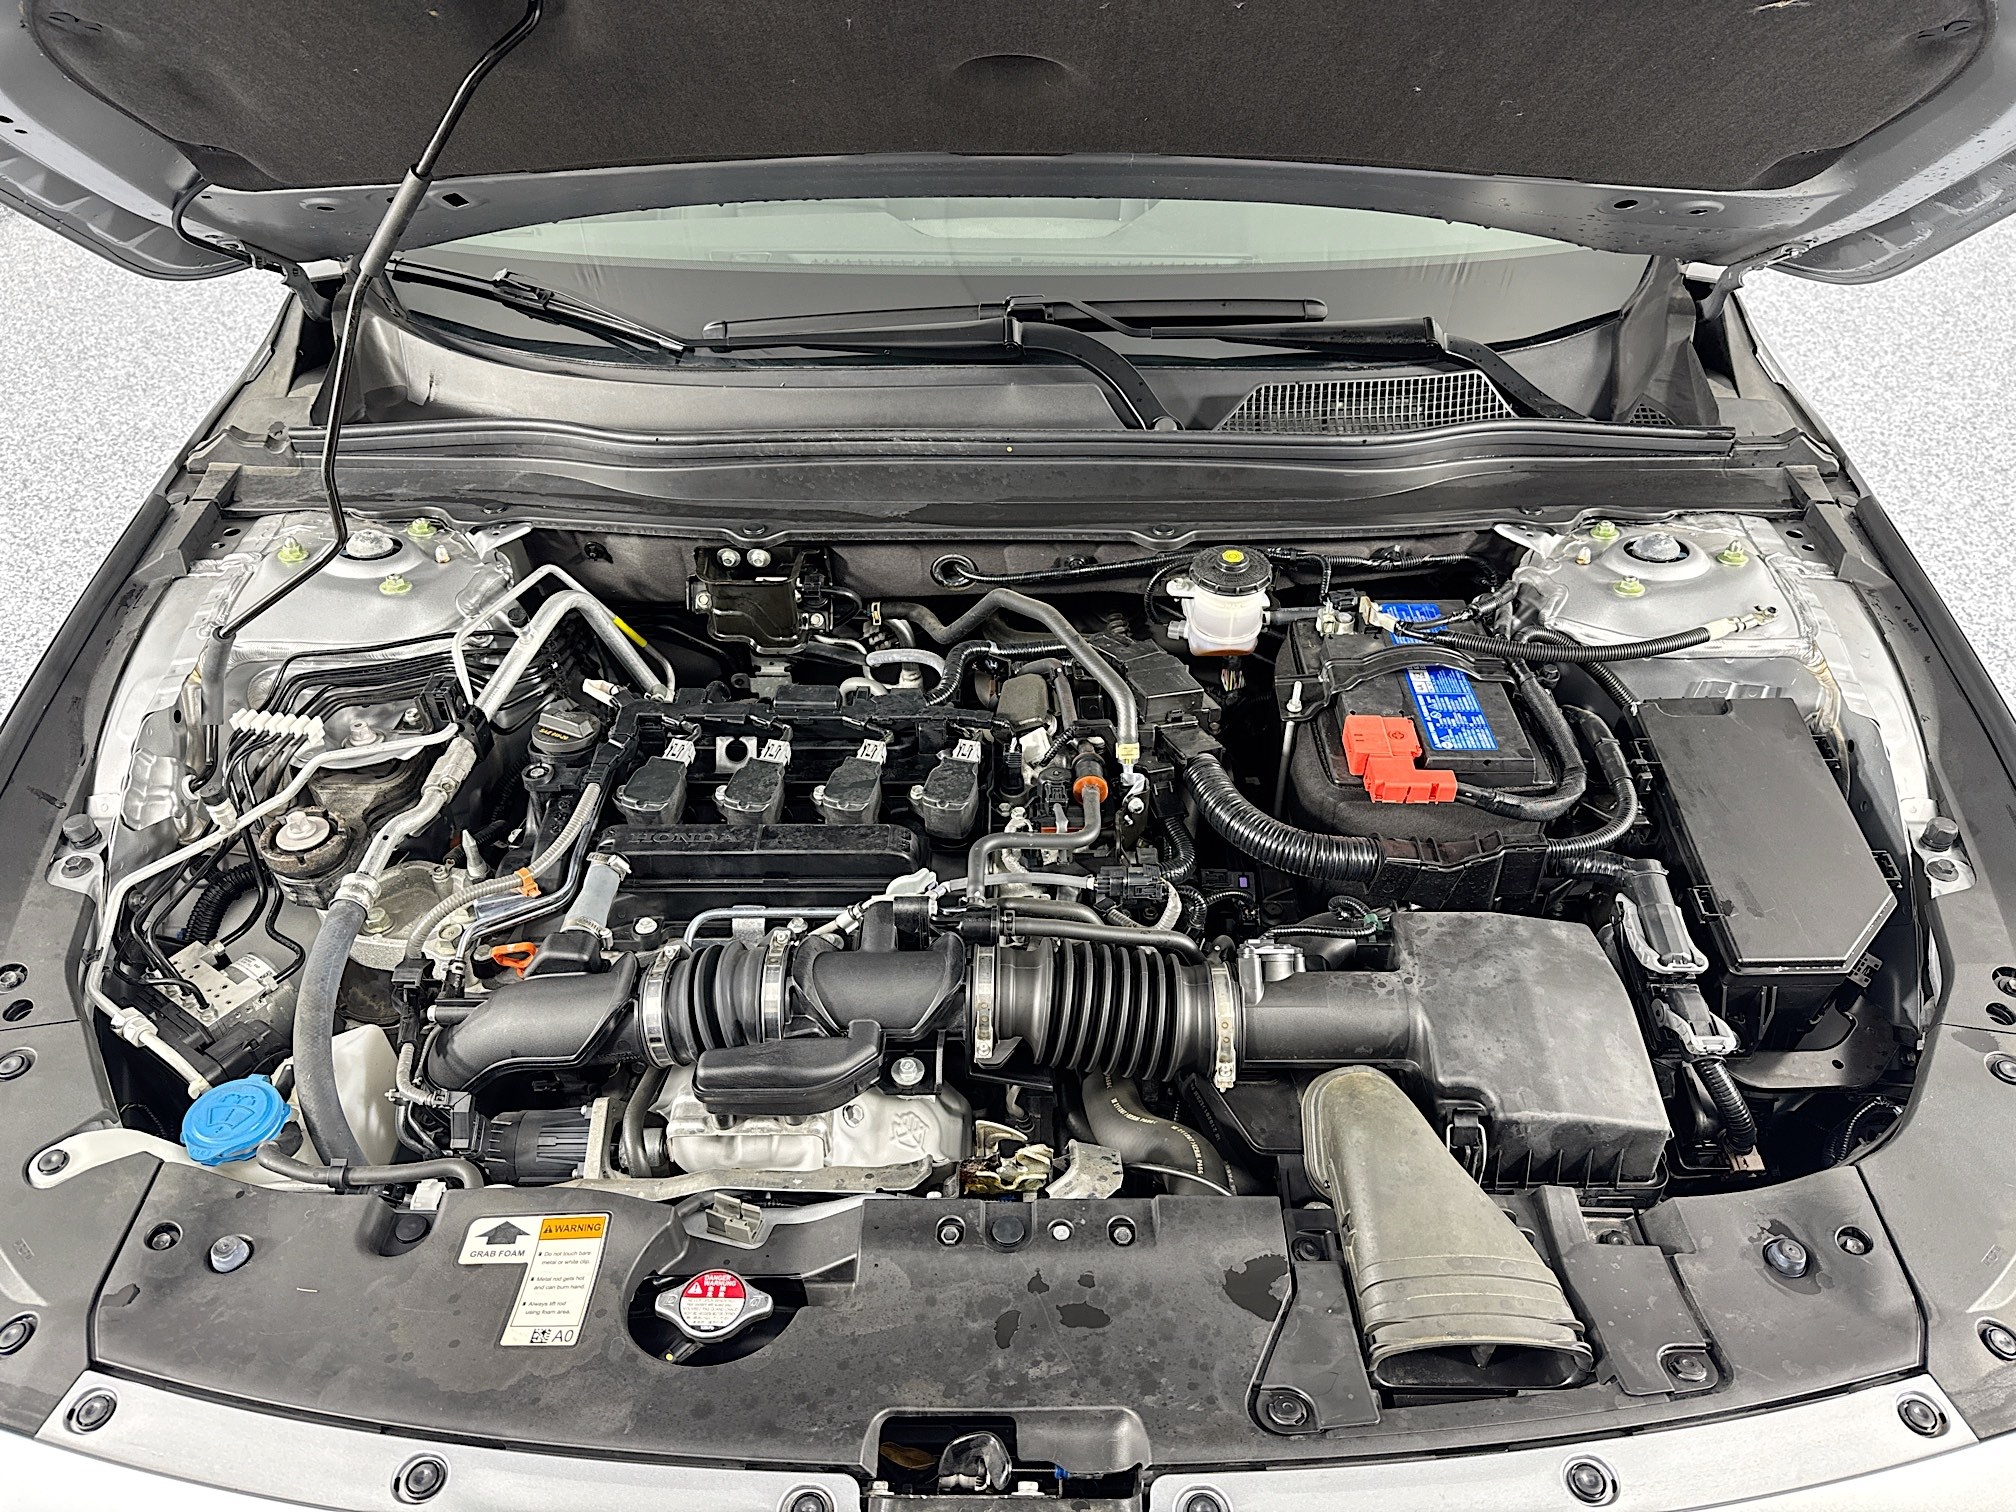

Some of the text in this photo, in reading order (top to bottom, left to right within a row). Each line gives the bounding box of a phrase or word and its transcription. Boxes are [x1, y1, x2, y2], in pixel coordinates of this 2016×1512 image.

[628, 832, 742, 844] HONDA
[554, 1223, 602, 1233] WARNING
[469, 1250, 496, 1258] GRAB
[551, 1329, 575, 1343] A0
